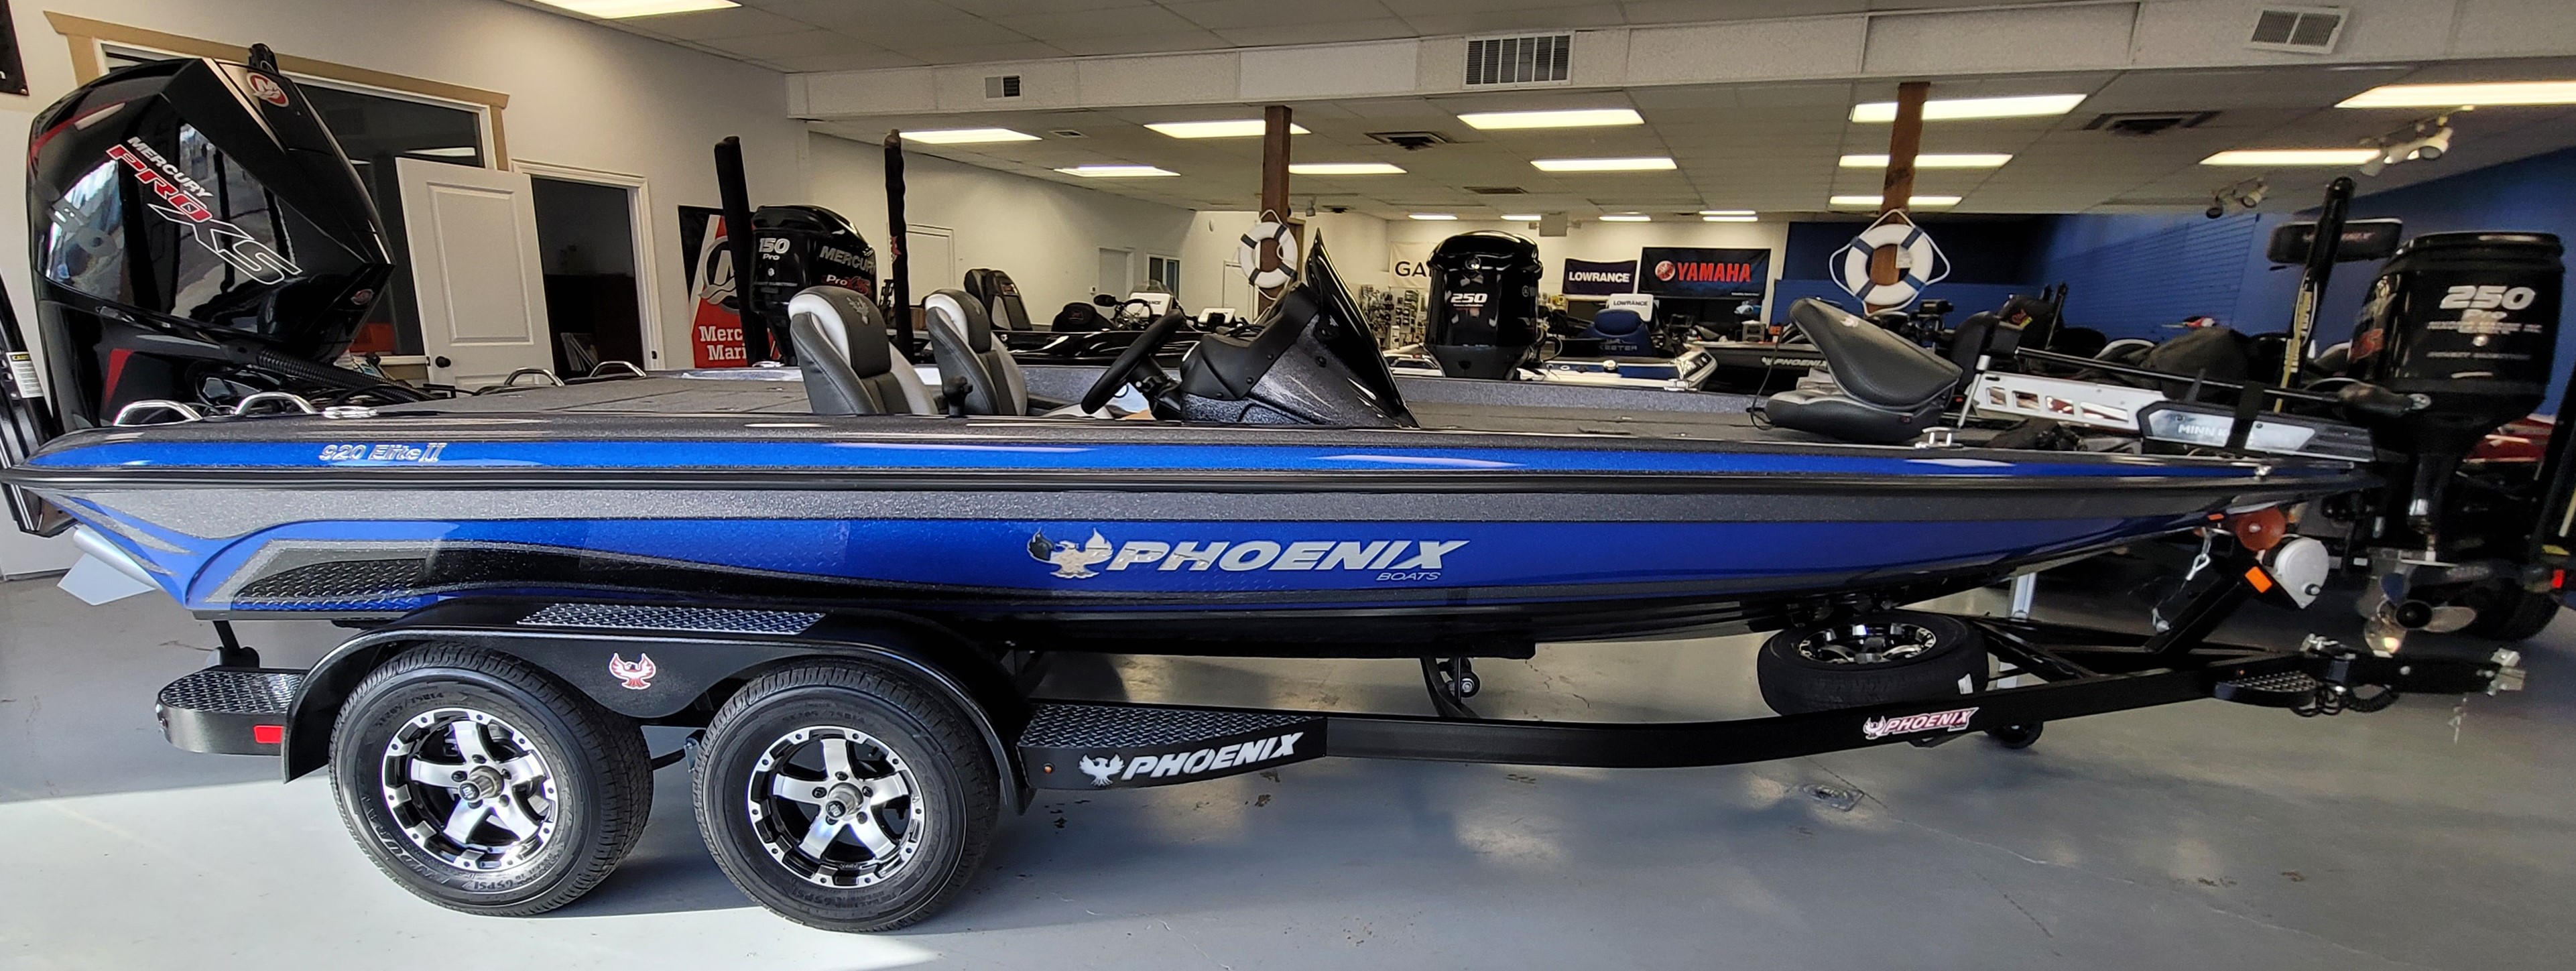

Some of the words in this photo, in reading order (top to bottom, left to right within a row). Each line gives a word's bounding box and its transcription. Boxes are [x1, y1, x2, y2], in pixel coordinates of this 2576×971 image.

[127, 136, 214, 198] MERCURY
[758, 237, 790, 254] 150
[819, 245, 877, 275] MERCUR
[1394, 260, 1431, 277] GA
[1569, 271, 1631, 283] LOWRANCE
[1676, 262, 1751, 282] YAMAHA
[1450, 293, 1488, 303] 250
[2439, 285, 2536, 310] 250
[698, 326, 743, 342] Merc
[707, 344, 747, 361] Mari
[2179, 424, 2215, 435] MINN
[318, 444, 367, 461] 920
[1105, 540, 1471, 572] PHOENIX
[1376, 572, 1442, 582] BOATS
[1884, 710, 1972, 733] PHOENIX
[1121, 732, 1304, 781] PHOENIX
